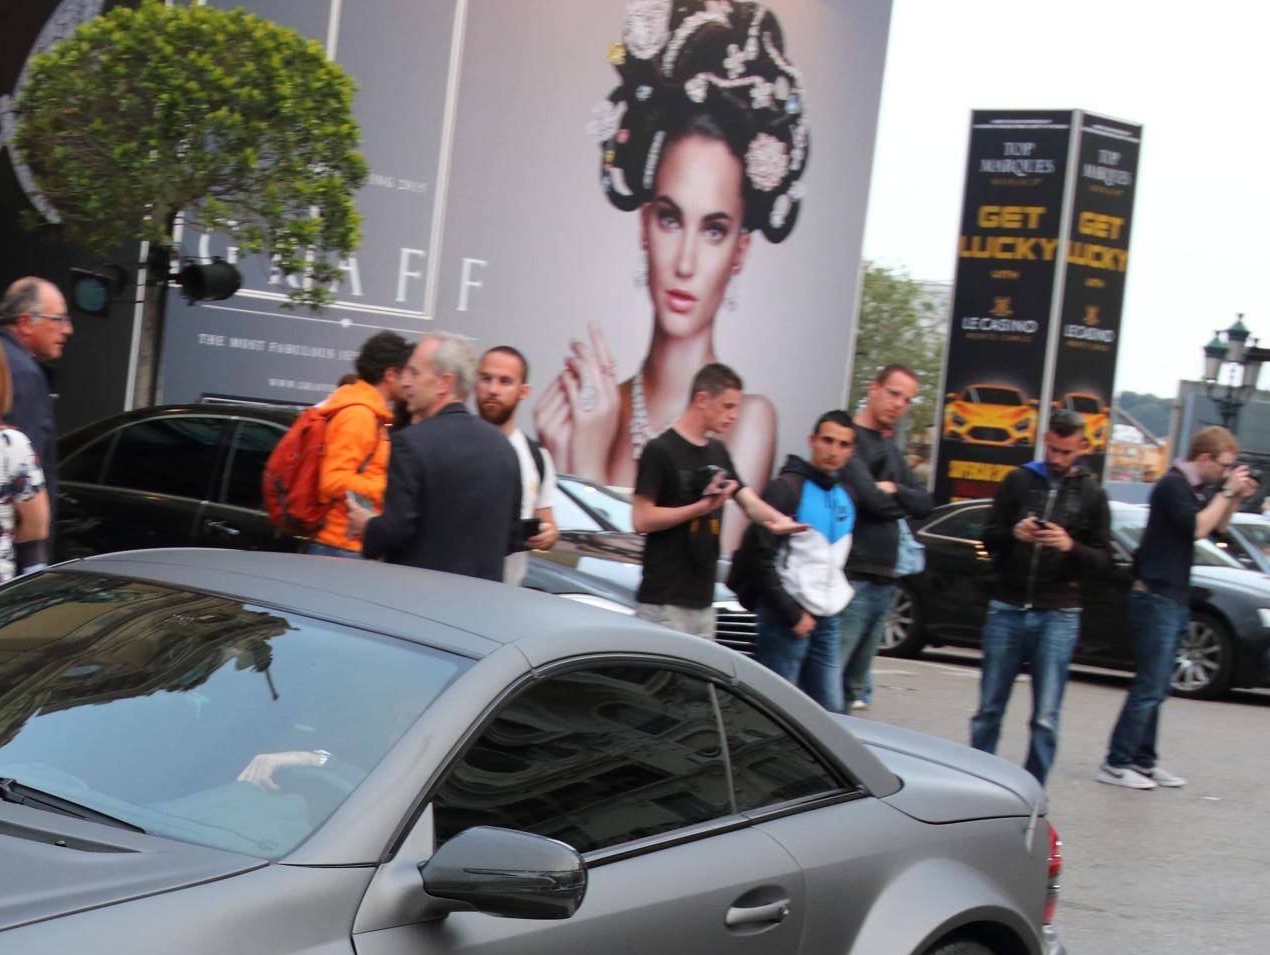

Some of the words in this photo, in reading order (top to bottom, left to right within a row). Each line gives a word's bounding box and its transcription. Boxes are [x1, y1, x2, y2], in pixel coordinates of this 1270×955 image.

[1002, 141, 1037, 156] TOP
[978, 158, 1056, 177] MARQUES
[977, 205, 1047, 229] GET
[1078, 210, 1125, 240] GET
[958, 235, 1059, 261] LUCKY
[979, 317, 1039, 334] CASINO
[198, 333, 227, 346] THE
